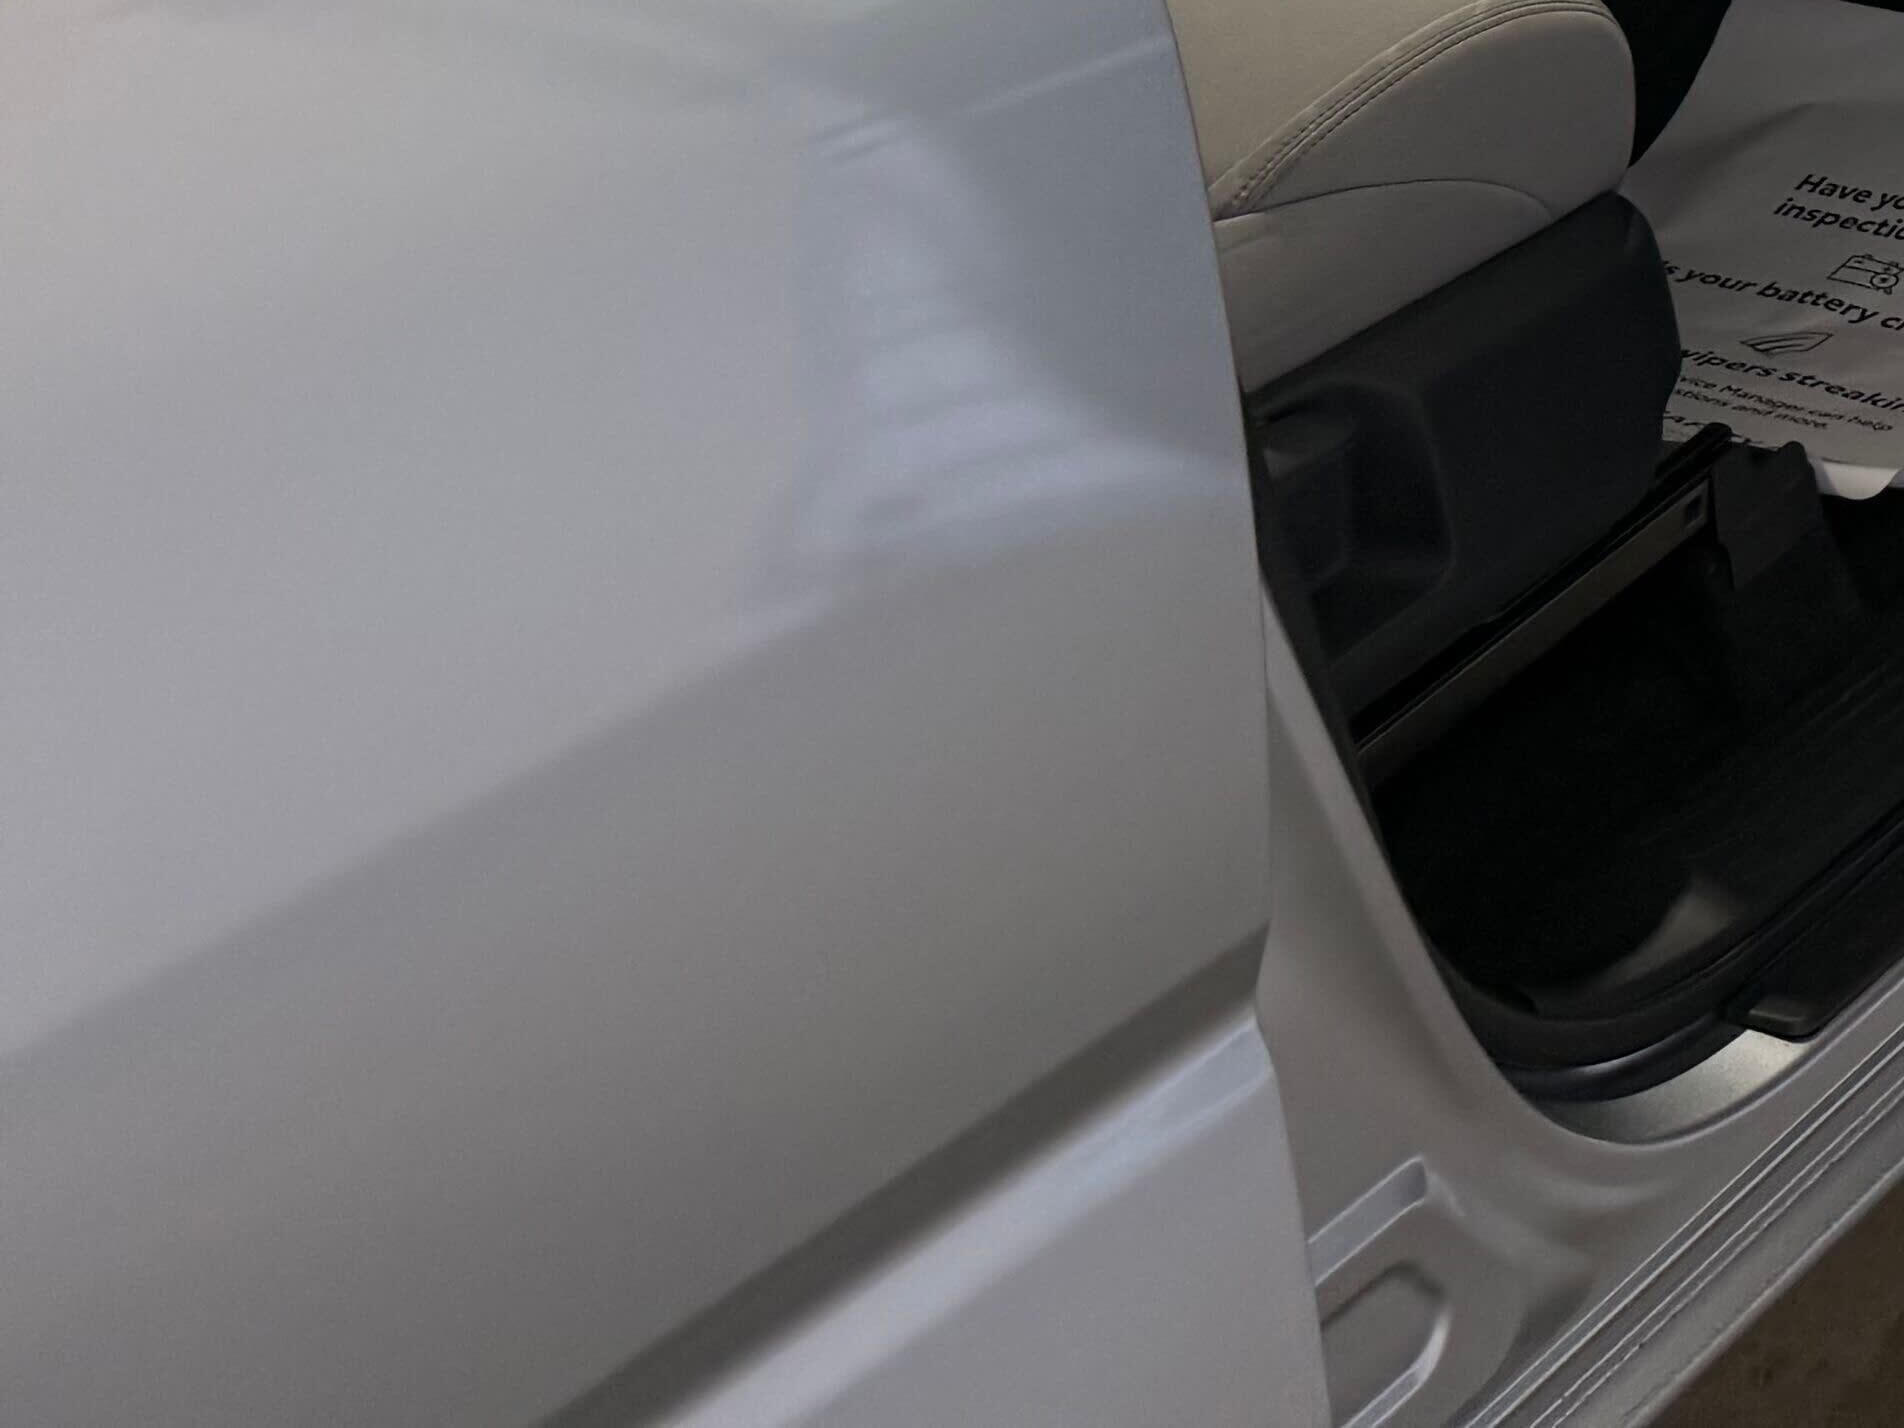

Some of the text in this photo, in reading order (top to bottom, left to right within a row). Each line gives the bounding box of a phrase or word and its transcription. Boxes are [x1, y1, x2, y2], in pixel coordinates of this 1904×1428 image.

[1794, 174, 1873, 203] Have
[1678, 268, 1758, 292] your
[1757, 281, 1880, 324] battery
[1719, 385, 1805, 412] Manager
